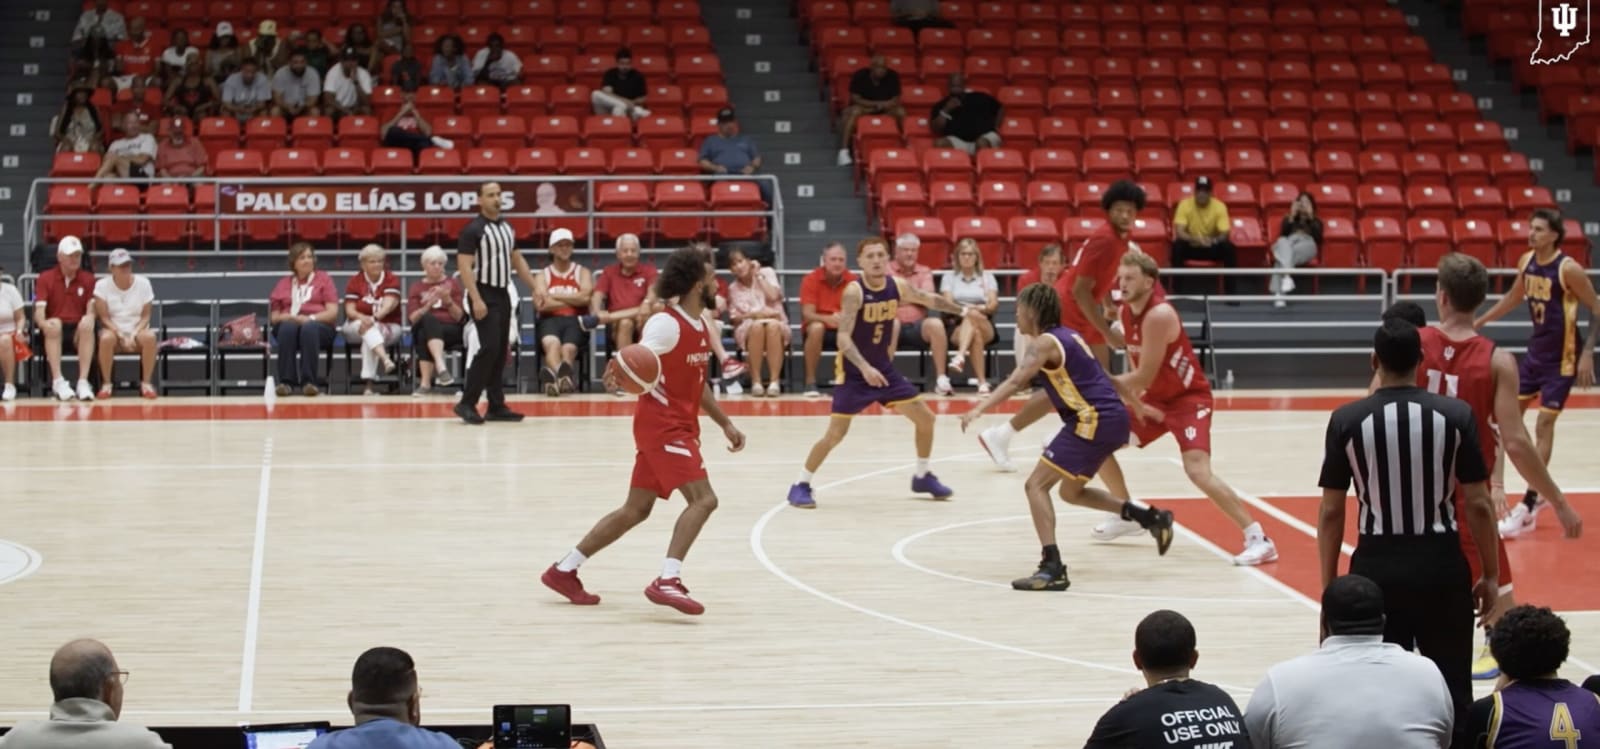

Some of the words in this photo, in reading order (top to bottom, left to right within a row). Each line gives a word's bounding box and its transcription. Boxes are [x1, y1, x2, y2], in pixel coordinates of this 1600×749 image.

[236, 192, 328, 212] PALCO
[335, 188, 416, 212] ELÍAS
[424, 191, 515, 211] LOPS
[872, 323, 885, 345] 5
[1427, 369, 1458, 397] 11
[1160, 705, 1235, 727] OFFICIAL
[1549, 702, 1582, 749] 4
[1163, 724, 1203, 744] USE
[1205, 720, 1241, 737] ONLY
